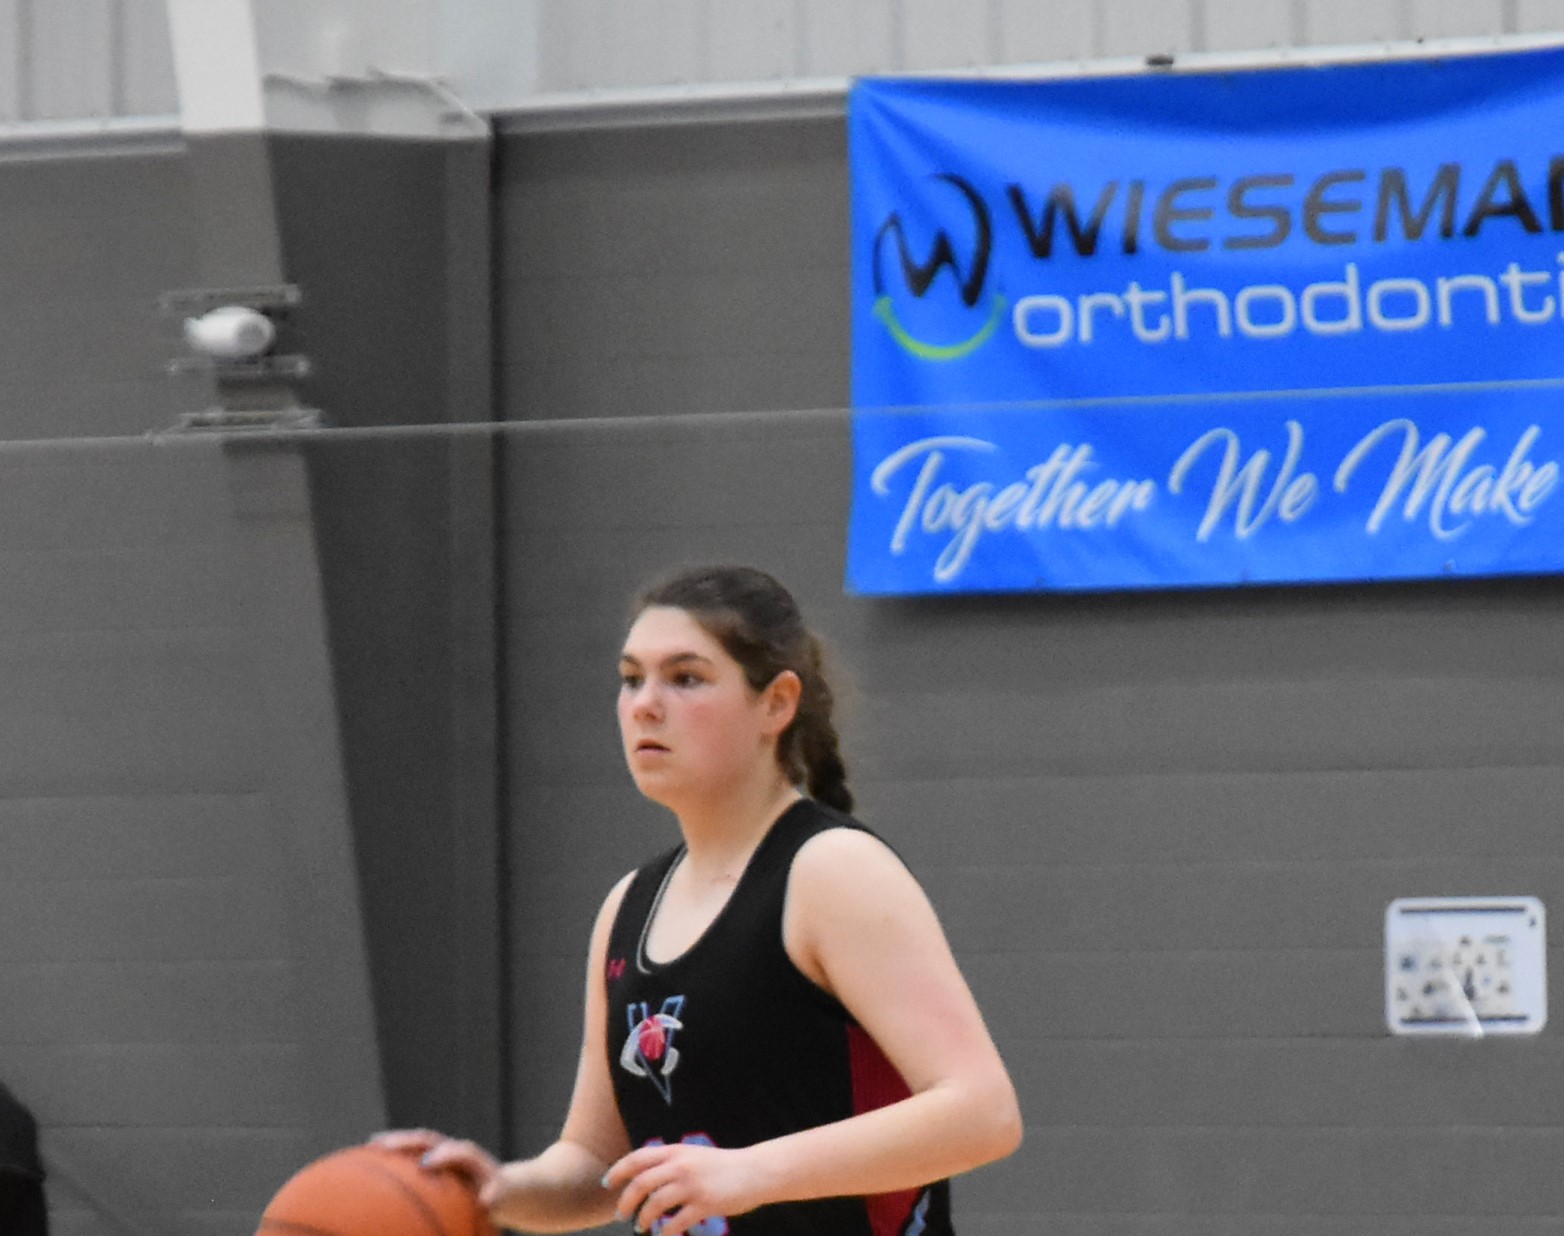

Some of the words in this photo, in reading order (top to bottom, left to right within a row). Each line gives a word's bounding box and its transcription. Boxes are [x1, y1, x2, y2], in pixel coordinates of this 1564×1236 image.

[872, 435, 1156, 583] Together
[1168, 420, 1318, 541] We
[1334, 417, 1560, 540] Make
